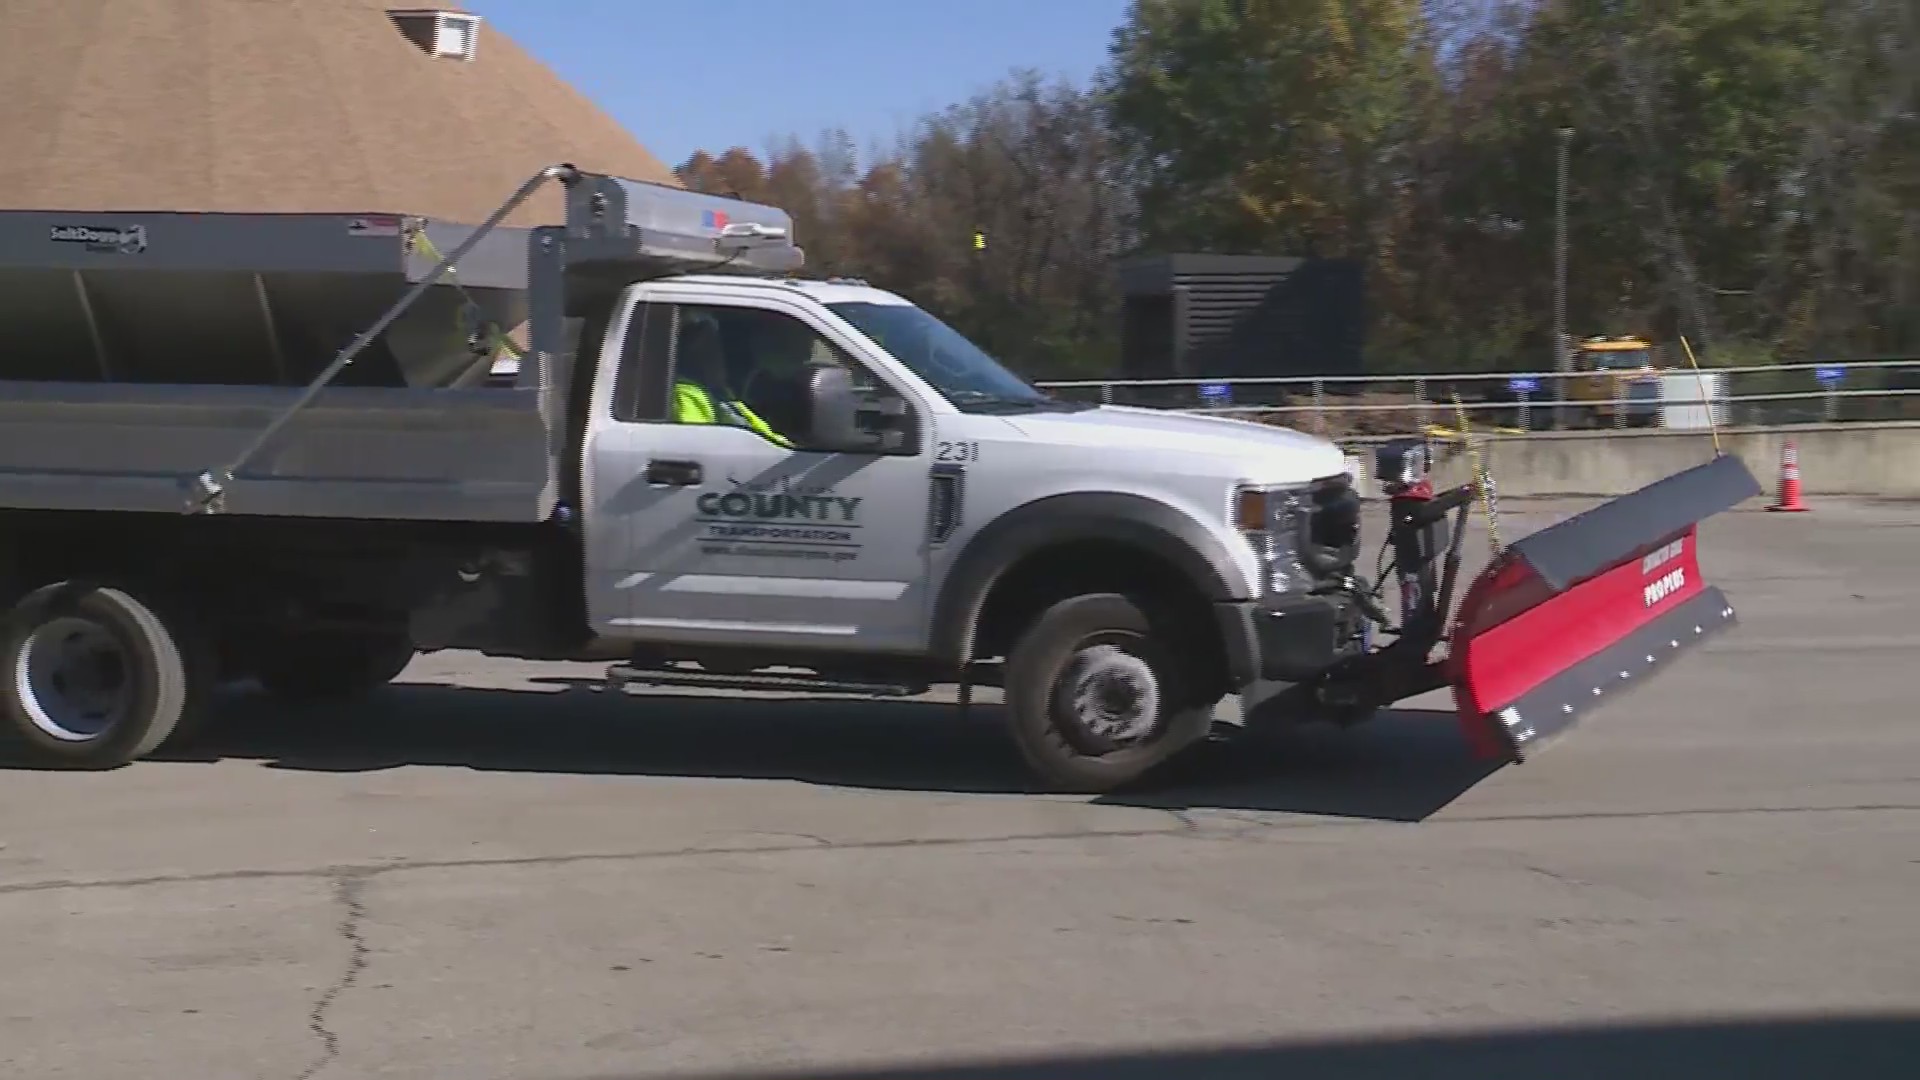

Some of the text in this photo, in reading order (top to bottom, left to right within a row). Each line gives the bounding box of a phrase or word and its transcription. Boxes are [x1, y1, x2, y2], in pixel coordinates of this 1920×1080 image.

[936, 441, 979, 462] 231
[696, 492, 864, 521] COUNTY
[709, 525, 852, 541] TRANSPORTATION
